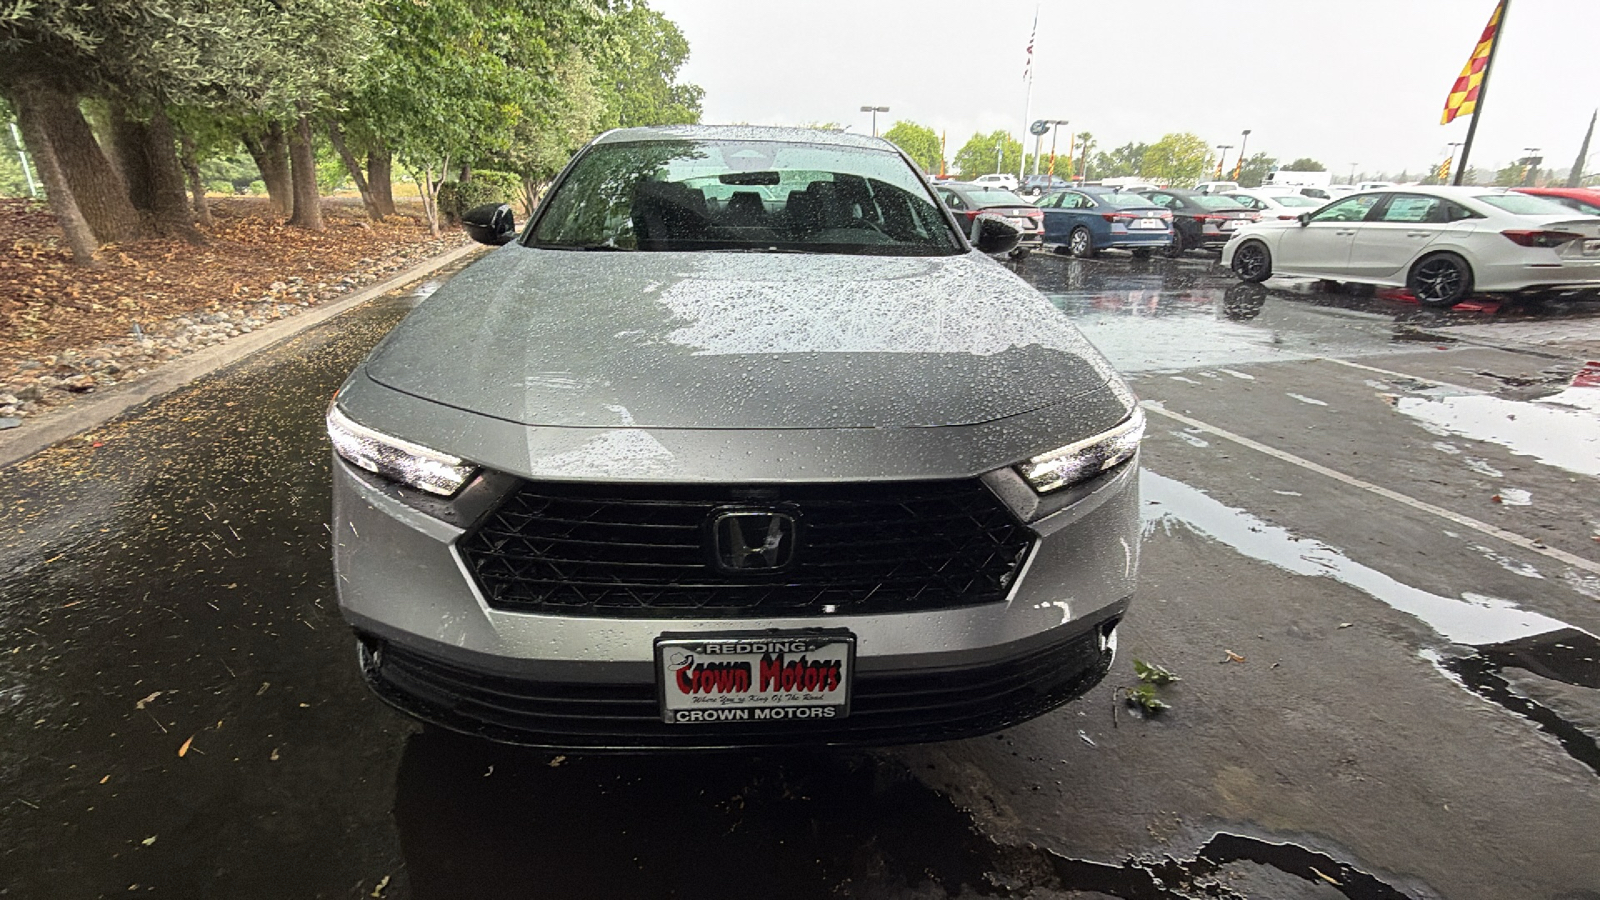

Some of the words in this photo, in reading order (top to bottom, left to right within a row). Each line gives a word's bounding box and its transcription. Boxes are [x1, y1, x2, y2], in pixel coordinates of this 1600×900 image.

[706, 642, 806, 654] REDDING
[676, 656, 752, 694] Crown
[760, 653, 842, 693] Motors
[748, 695, 769, 703] King
[771, 694, 782, 703] Of
[784, 693, 800, 701] The
[676, 709, 749, 721] CROWN
[754, 707, 836, 719] MOTORS
